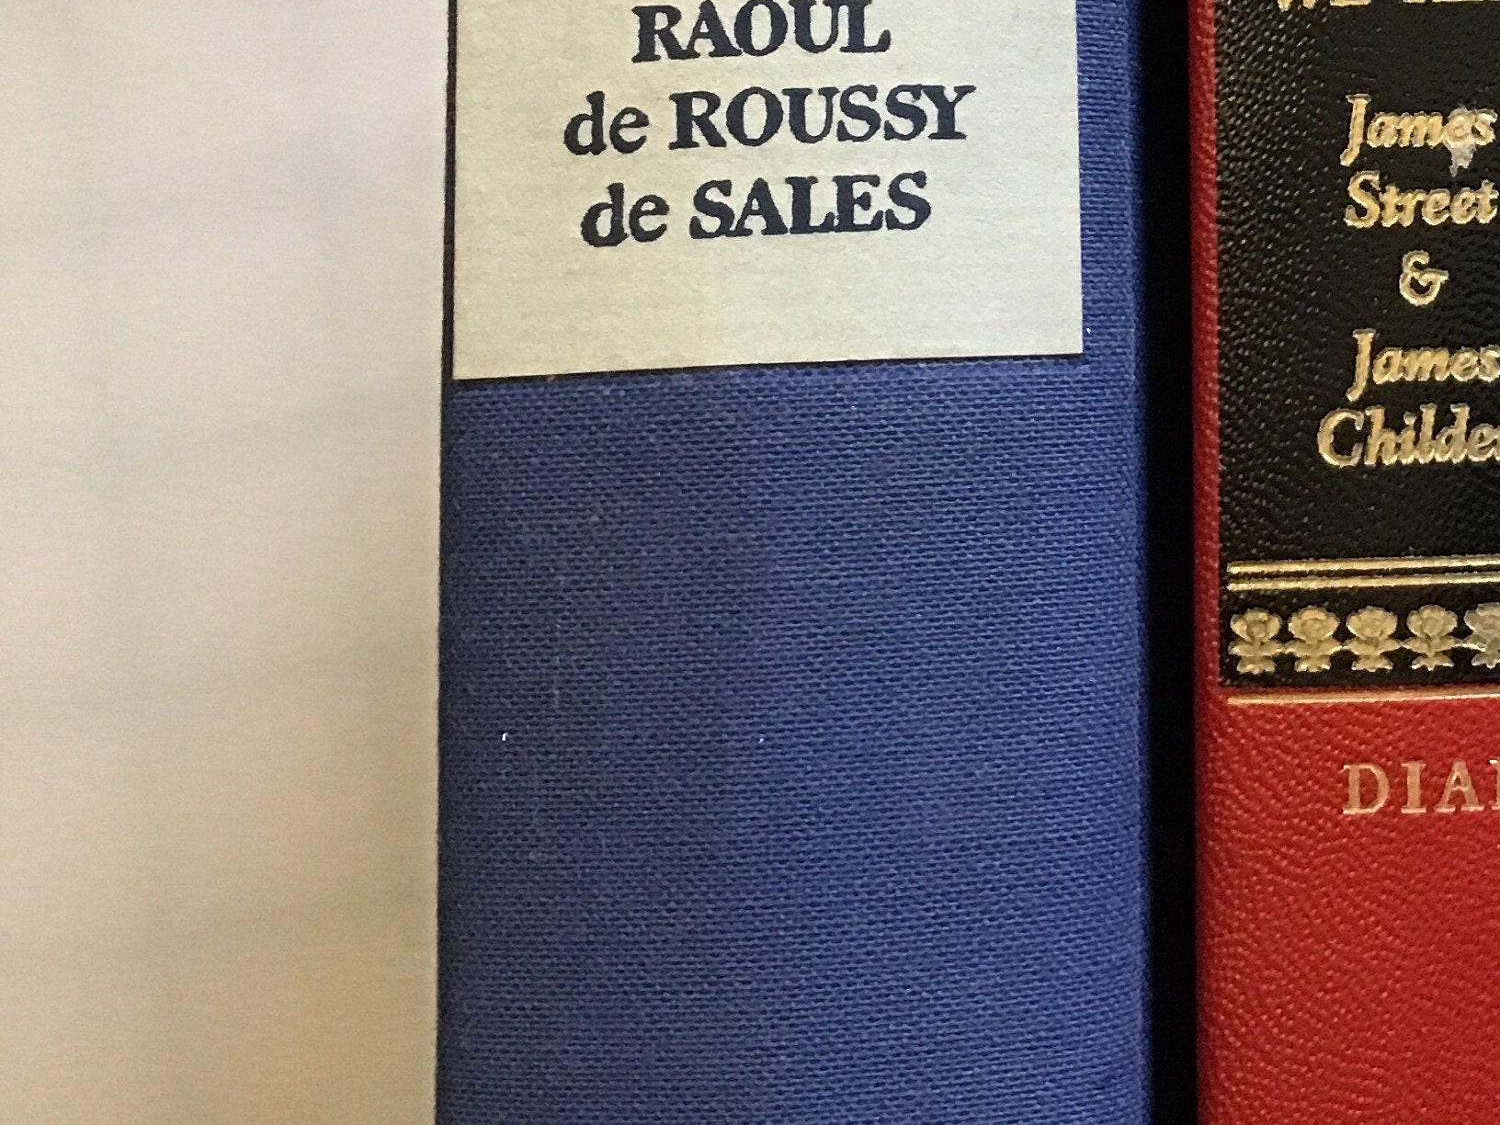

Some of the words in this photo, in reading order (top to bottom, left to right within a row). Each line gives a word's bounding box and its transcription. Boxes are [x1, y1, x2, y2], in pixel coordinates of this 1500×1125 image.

[563, 92, 650, 155] de
[668, 85, 976, 149] ROUSSY
[1340, 92, 1498, 167] James
[580, 182, 669, 247] de
[689, 171, 932, 240] SALES
[1344, 170, 1500, 228] Street
[1399, 249, 1449, 306] &
